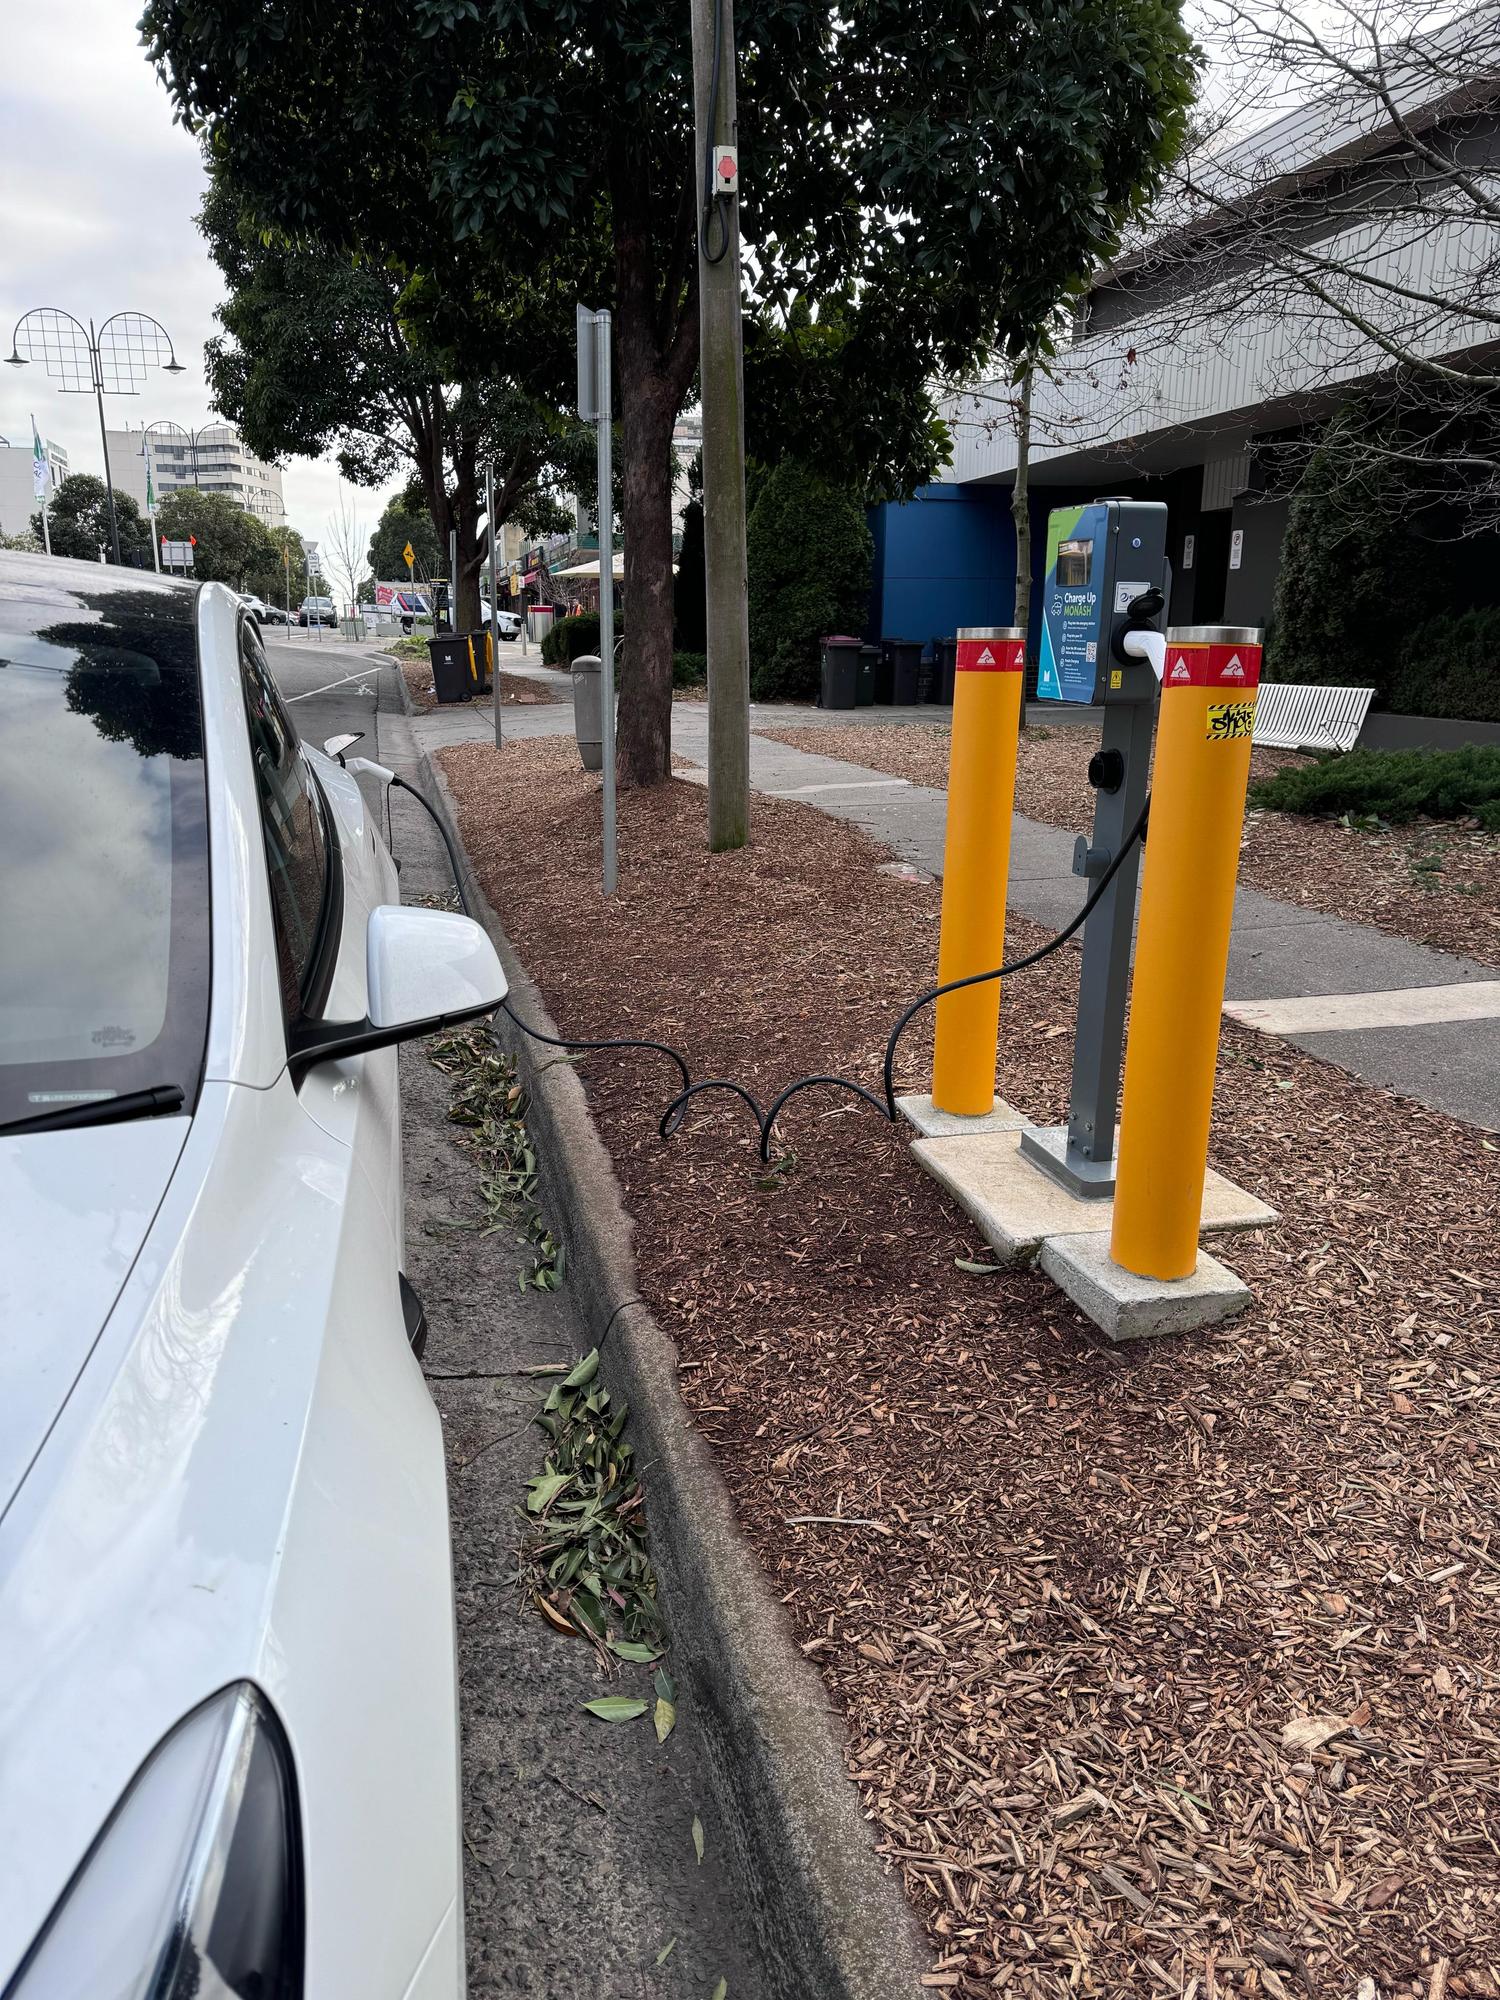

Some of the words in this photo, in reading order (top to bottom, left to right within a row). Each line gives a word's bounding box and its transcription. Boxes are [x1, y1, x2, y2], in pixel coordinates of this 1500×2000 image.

[1064, 592, 1086, 605] Charge
[1086, 592, 1096, 605] Up
[1064, 605, 1092, 616] MONASH
